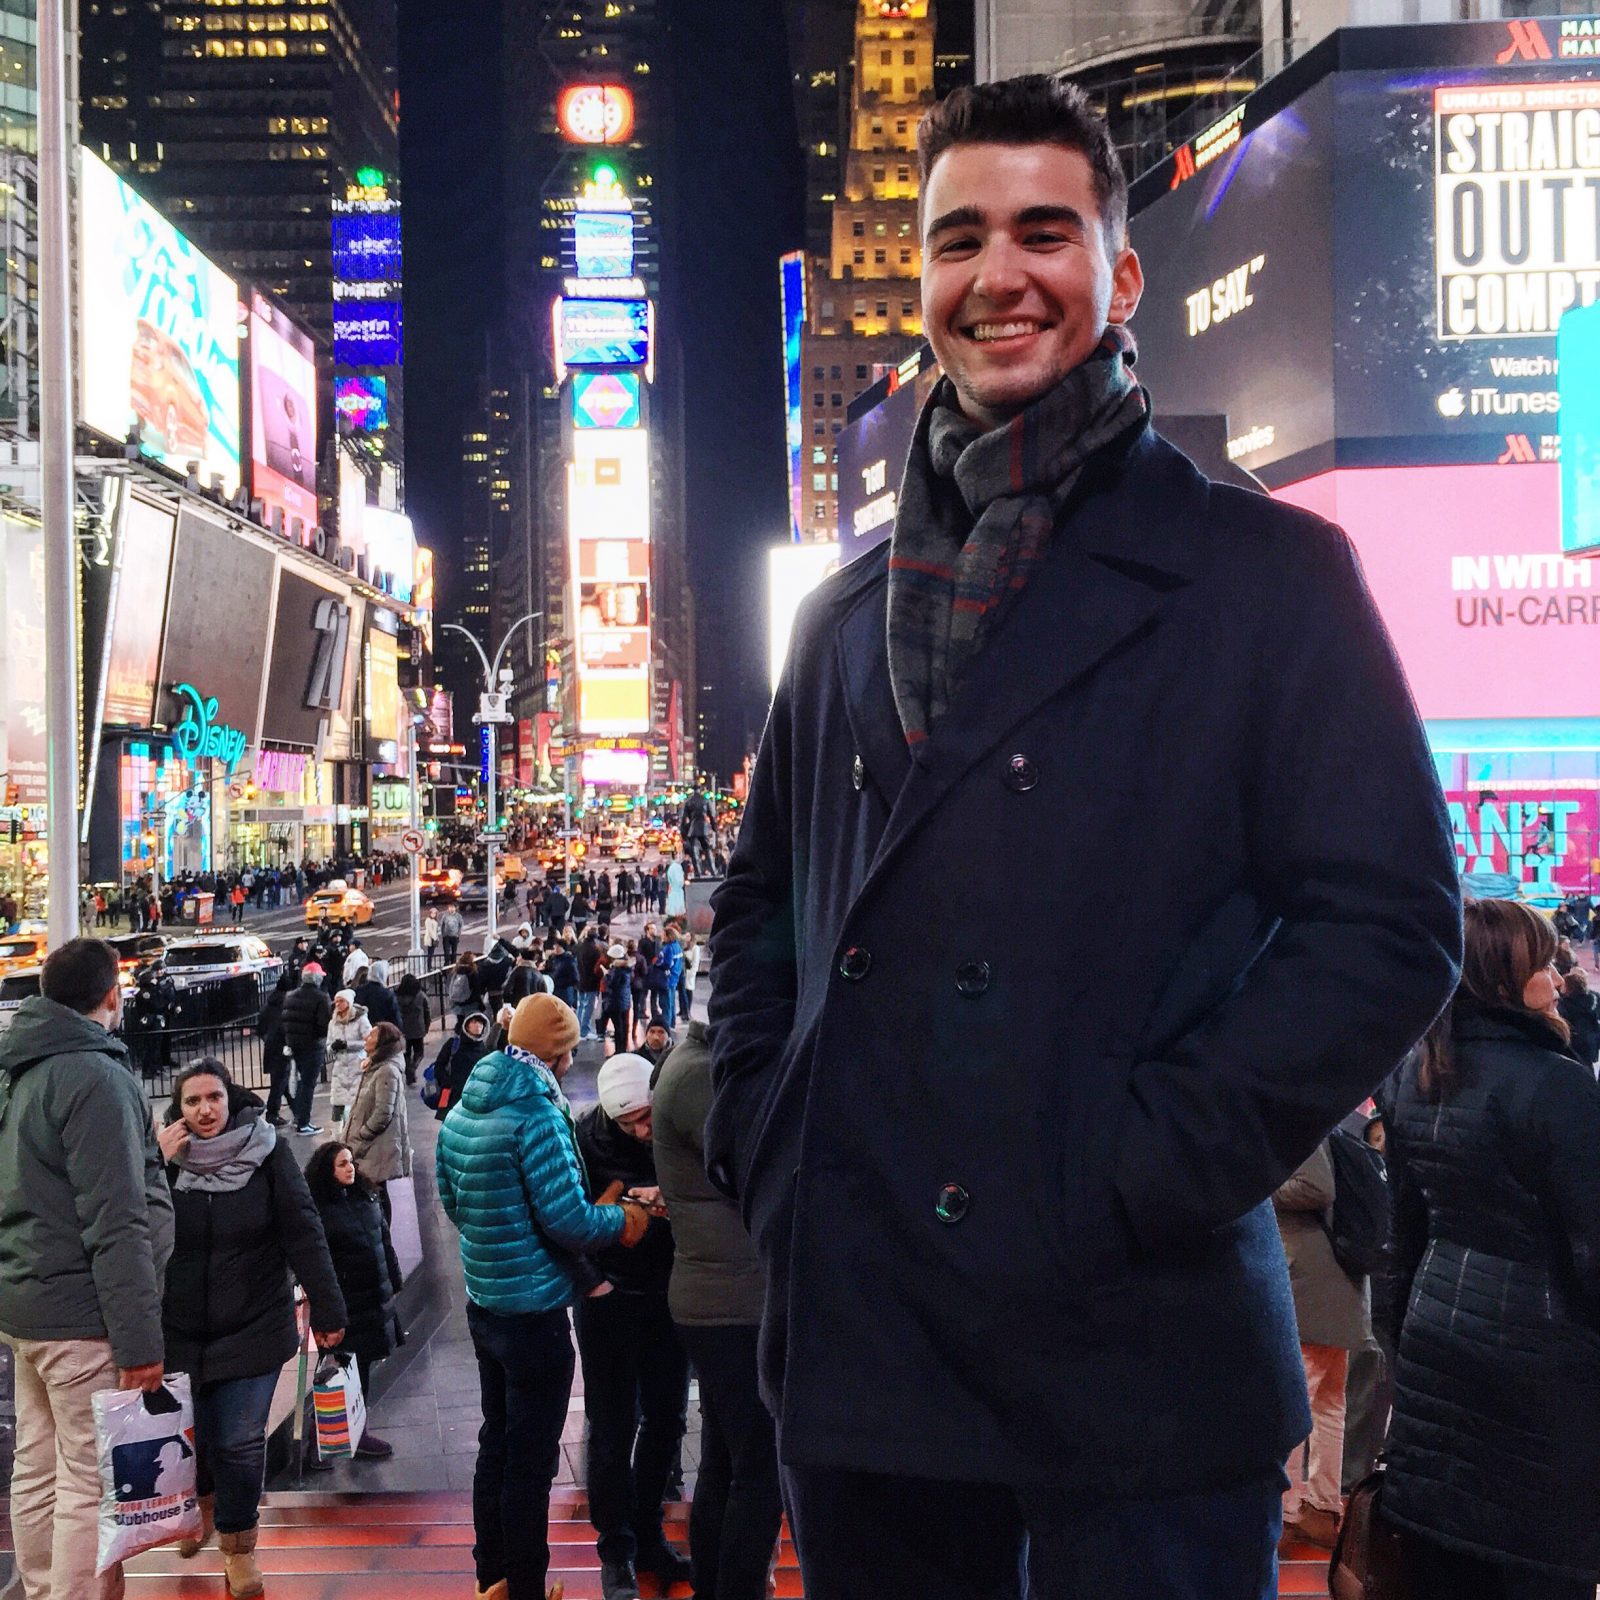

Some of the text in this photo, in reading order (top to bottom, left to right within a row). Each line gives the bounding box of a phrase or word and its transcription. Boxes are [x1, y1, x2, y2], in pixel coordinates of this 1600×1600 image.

[1441, 91, 1522, 110] UNRATED
[1186, 287, 1211, 337] TO
[1490, 355, 1549, 378] Watch
[1470, 387, 1561, 416] iTunes
[1451, 553, 1592, 590] IN WITH
